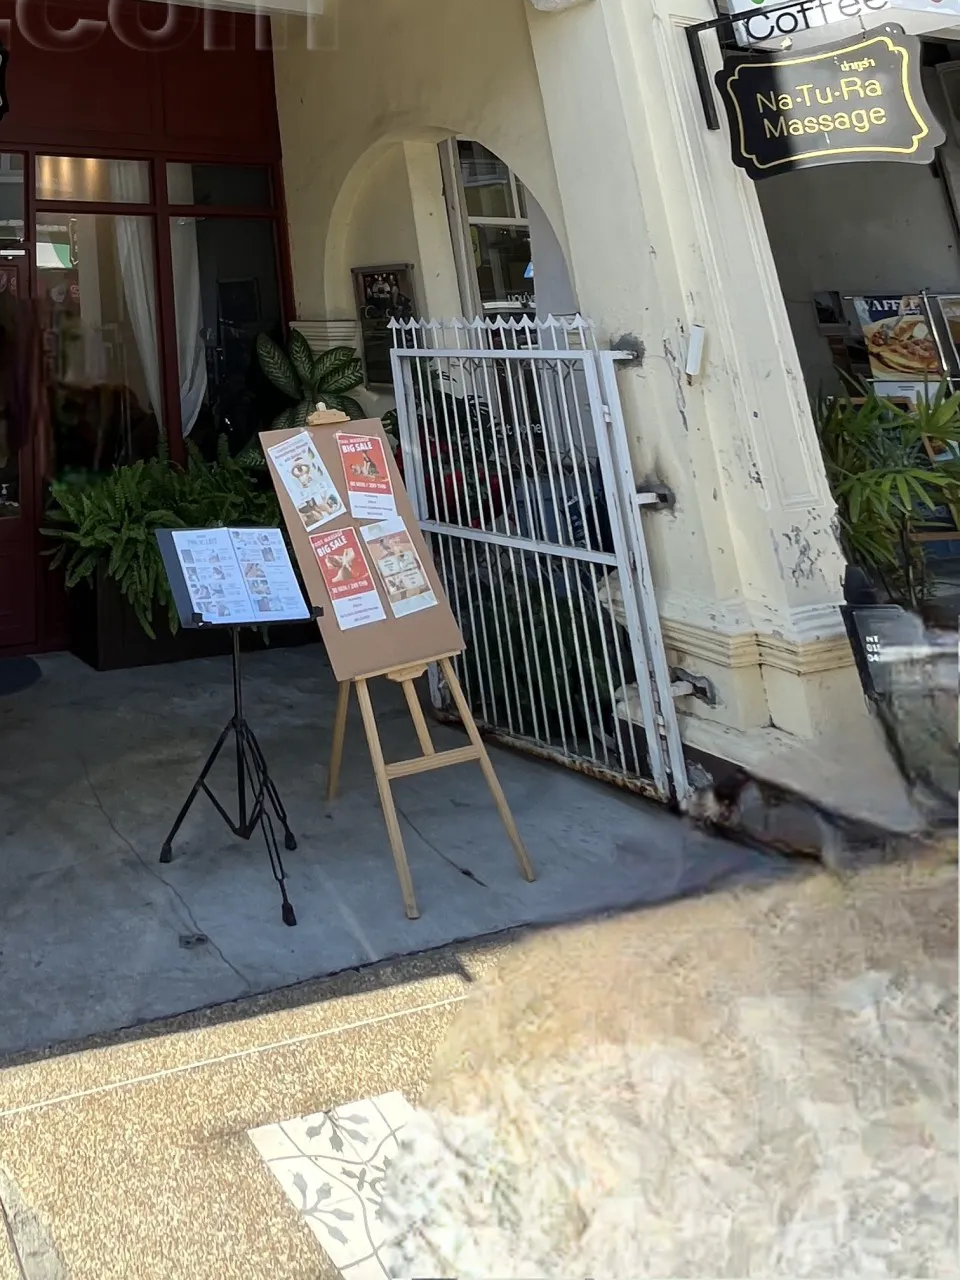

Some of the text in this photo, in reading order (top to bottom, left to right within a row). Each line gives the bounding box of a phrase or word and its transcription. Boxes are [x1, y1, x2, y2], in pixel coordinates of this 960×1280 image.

[763, 107, 887, 139] Massage
[341, 441, 372, 453] BIG SALE
[316, 535, 347, 557] BIG SALE
